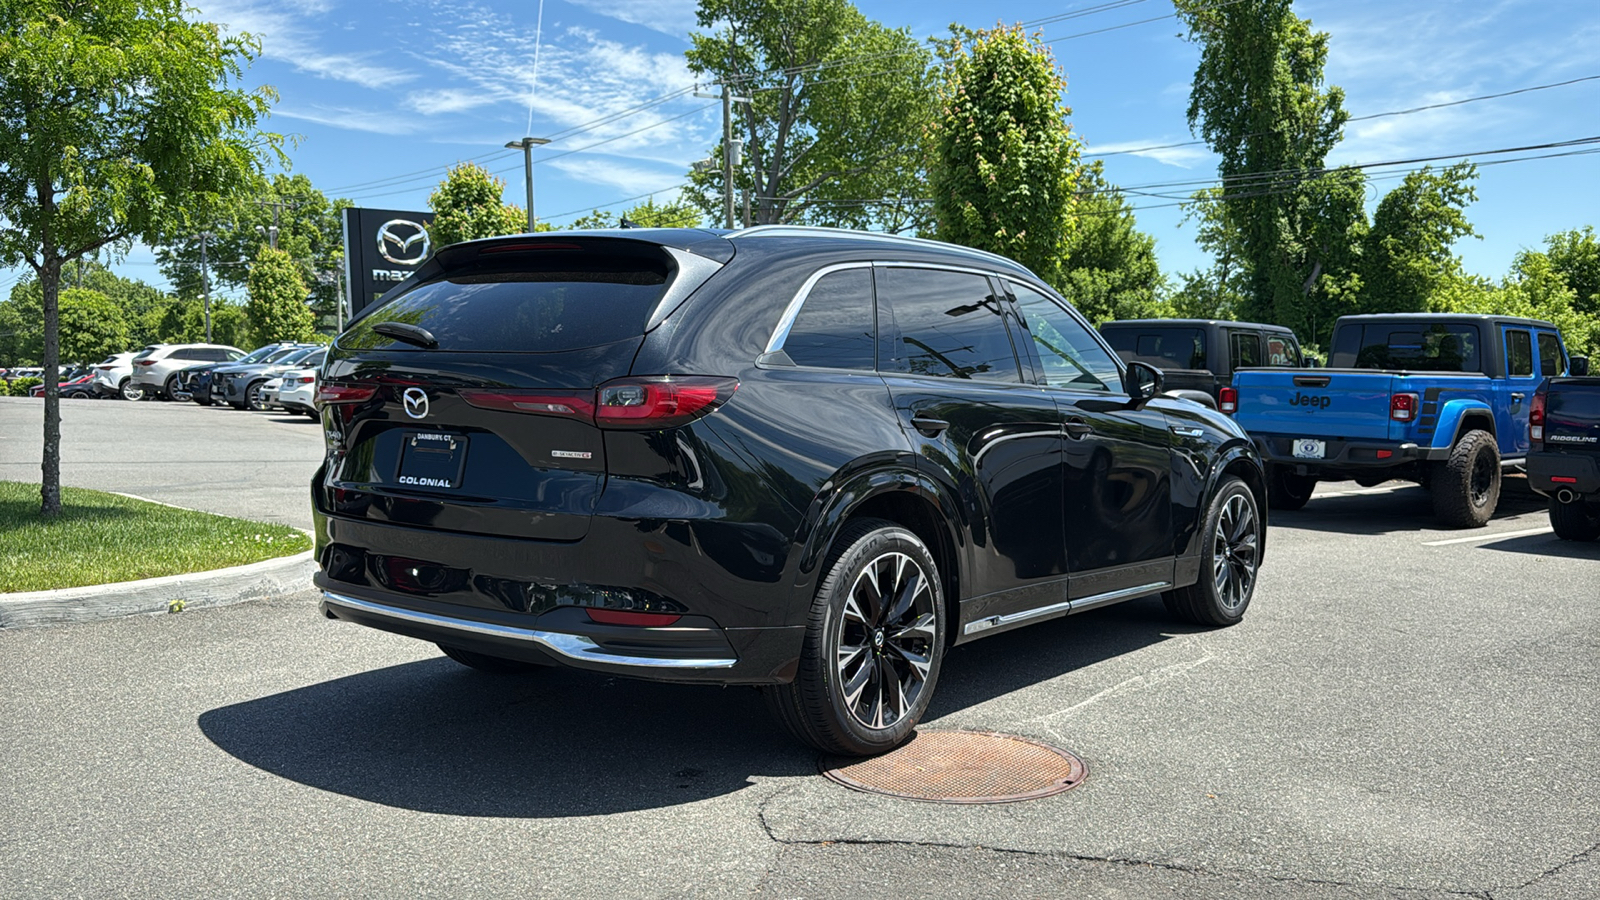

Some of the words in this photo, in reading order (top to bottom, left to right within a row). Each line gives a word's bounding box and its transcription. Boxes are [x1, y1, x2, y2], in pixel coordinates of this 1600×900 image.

[372, 269, 415, 281] maz
[1289, 392, 1331, 410] Jeep
[1550, 435, 1598, 443] RIDGELINE
[398, 476, 451, 488] COLONIAL
